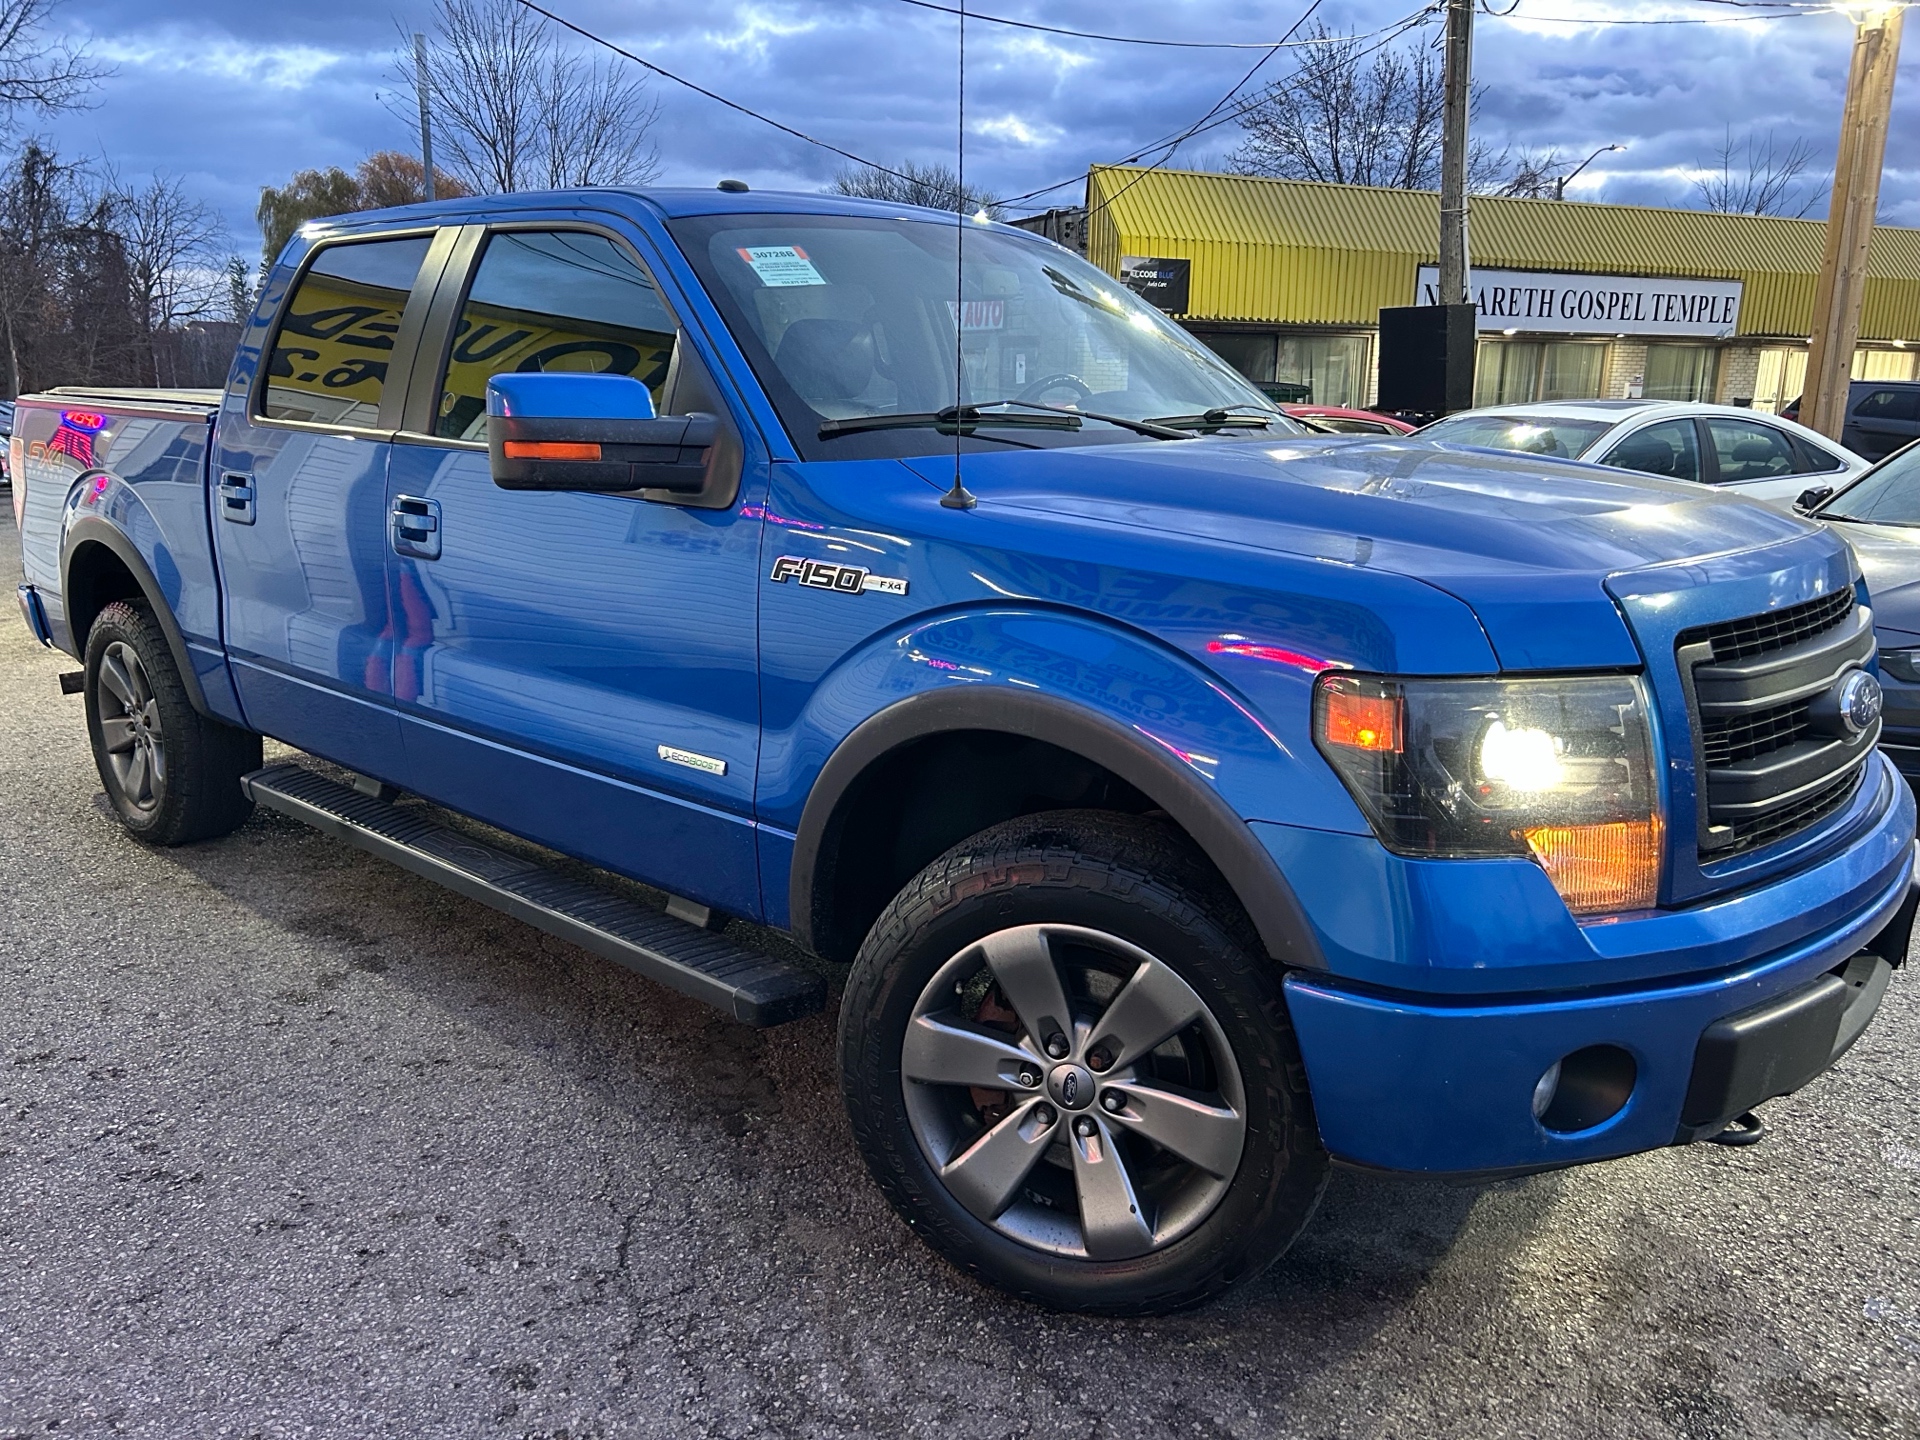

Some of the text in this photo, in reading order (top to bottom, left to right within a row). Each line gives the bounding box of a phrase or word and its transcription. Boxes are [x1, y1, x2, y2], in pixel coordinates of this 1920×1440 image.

[753, 250, 796, 259] 30728B
[1147, 280, 1158, 288] Auto
[1158, 271, 1174, 279] BLUE
[964, 301, 1003, 328] AUTO
[1423, 283, 1736, 325] NARETH GOSPEL TEMPLE
[29, 440, 65, 473] FX4
[771, 556, 902, 594] F-150 FX4
[671, 752, 720, 771] ECOBOOST
